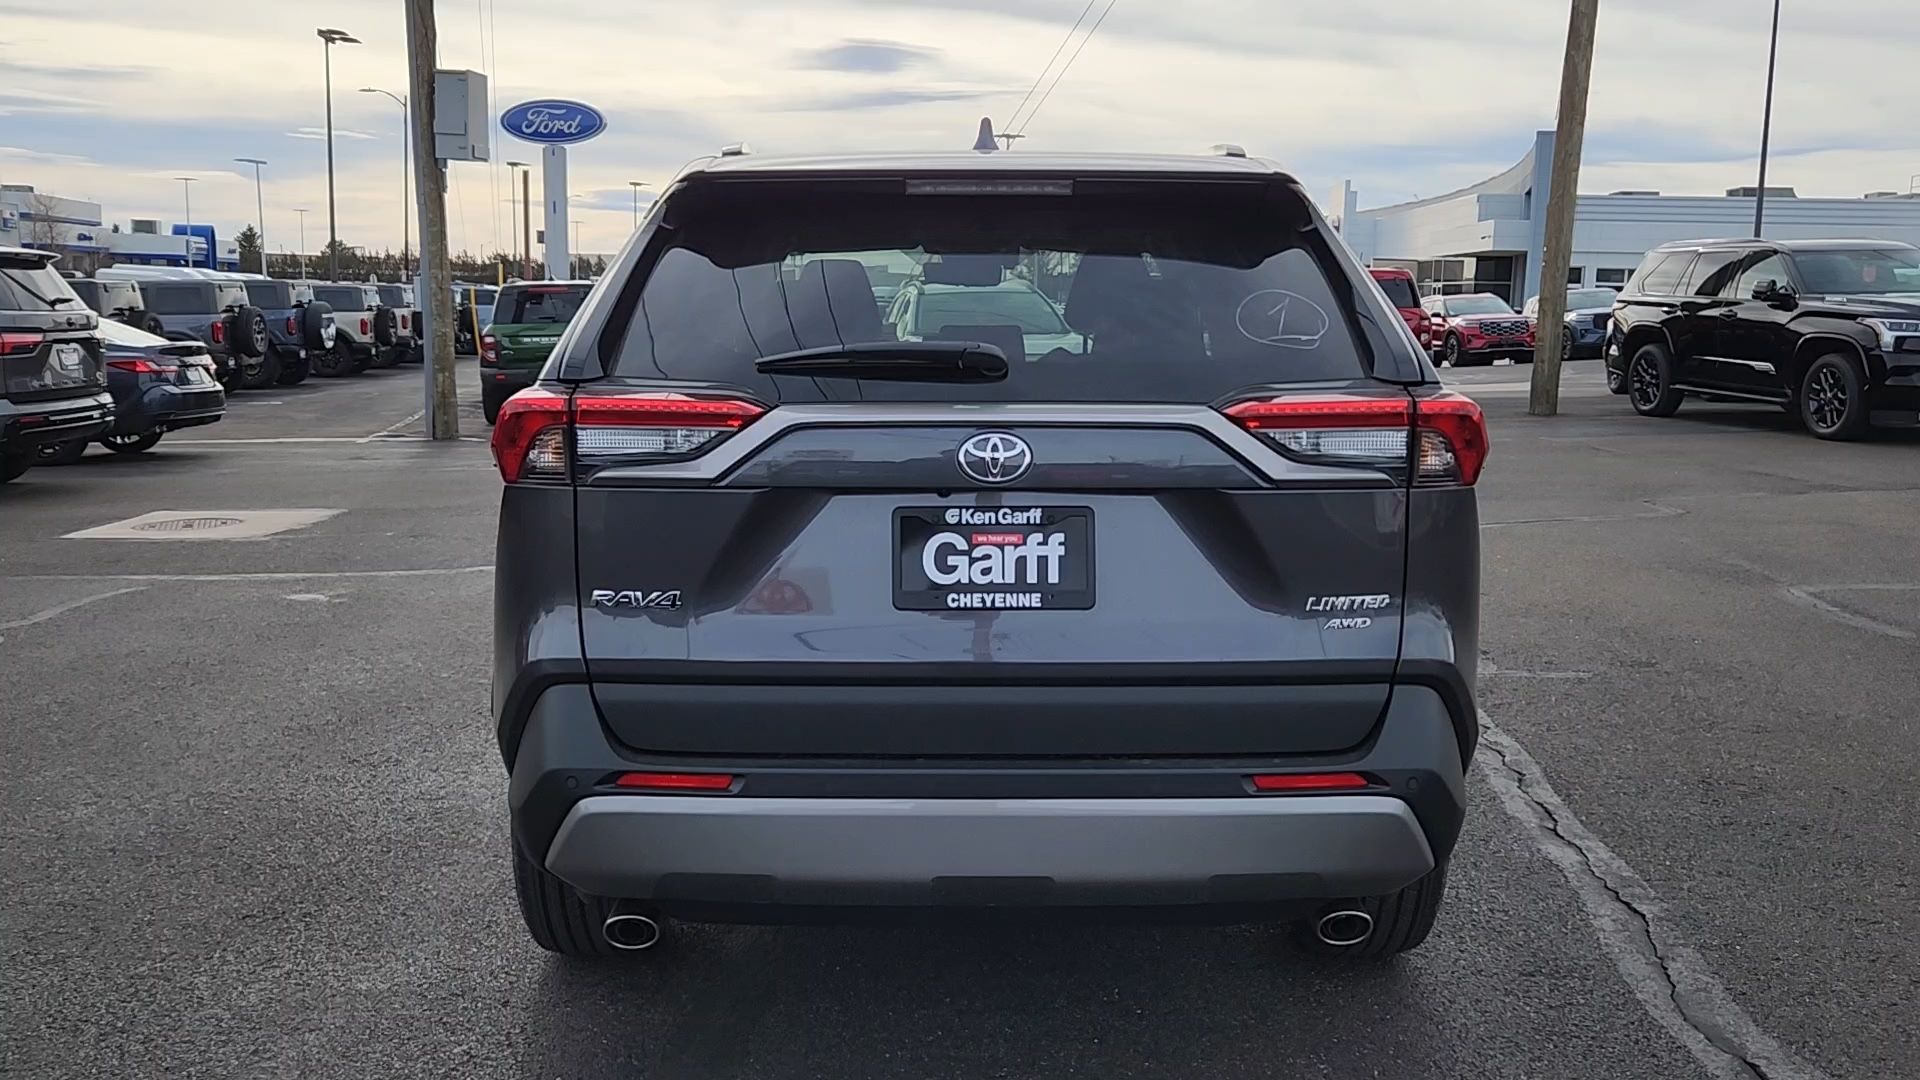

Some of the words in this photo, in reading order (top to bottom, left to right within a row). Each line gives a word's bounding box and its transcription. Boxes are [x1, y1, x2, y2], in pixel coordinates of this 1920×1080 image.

[522, 107, 582, 134] Ford
[961, 507, 996, 524] Ken
[997, 507, 1043, 524] Garff
[988, 534, 1003, 542] hear
[1004, 535, 1018, 543] you
[922, 532, 1065, 585] Garff
[590, 589, 682, 611] RAV4
[946, 592, 1042, 608] CHEYENNE
[1305, 594, 1390, 611] LIMITED
[1323, 617, 1372, 630] AWD
